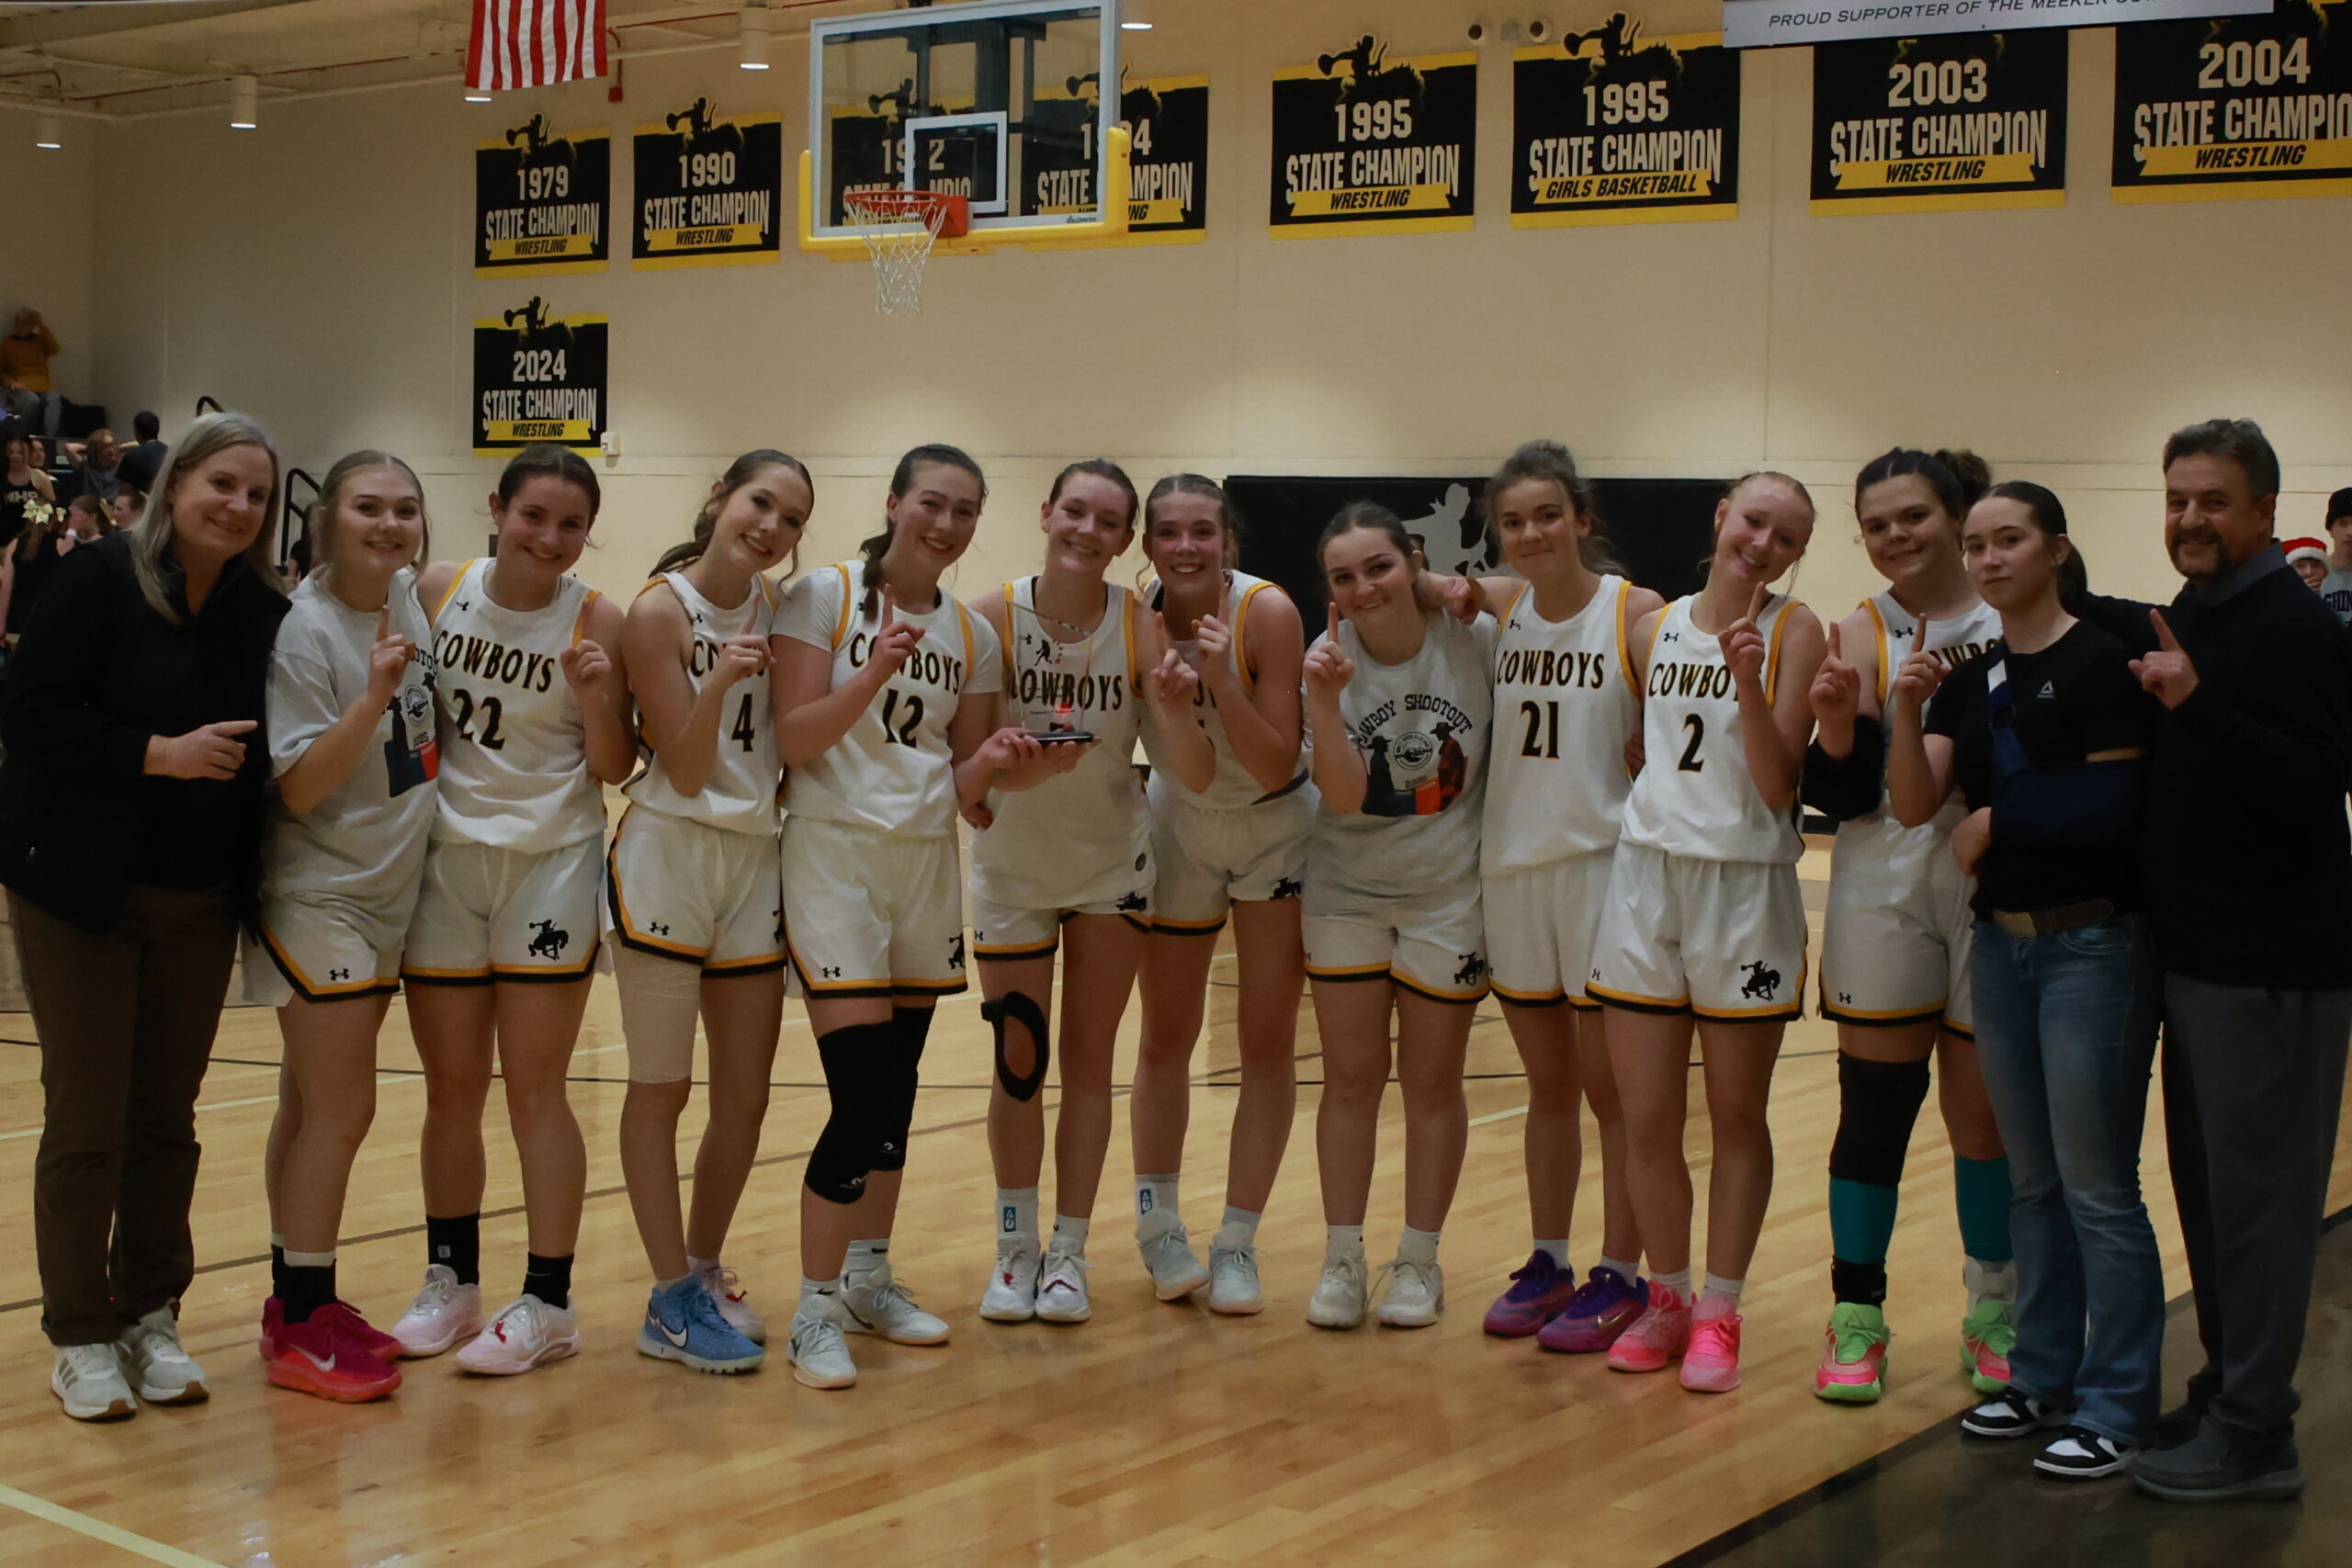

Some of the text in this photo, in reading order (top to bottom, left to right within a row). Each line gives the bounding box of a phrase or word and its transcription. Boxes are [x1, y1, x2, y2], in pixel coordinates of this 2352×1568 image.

[1769, 12, 1831, 28] PROUD
[1838, 4, 1949, 23] SUPPORTER
[1956, 2, 1980, 15] OF
[1988, 0, 2024, 12] THE
[1888, 59, 1986, 107] 2003
[2199, 37, 2311, 89] 2004
[1335, 99, 1413, 142] 1995
[1582, 81, 1668, 126] 1995
[1829, 109, 2047, 177] STATE CHAMPION
[2133, 93, 2352, 163] STATE CHAMPIO
[679, 151, 735, 188] 1990
[881, 139, 945, 175] 192
[1285, 144, 1460, 206] STATE CHAMPION
[1529, 128, 1722, 192] STATE CHAMPION
[1886, 160, 1985, 183] WRESTLING
[2196, 145, 2307, 169] WRESTLING
[517, 165, 569, 200] 1979
[1037, 169, 1091, 215] STATE
[1330, 190, 1409, 210] WRESTLING
[1546, 175, 1697, 199] GIRLS BASKETBALL
[485, 202, 600, 251] STATE CHAMPION
[643, 189, 770, 241] STATE CHAMPION
[675, 228, 734, 246] WRESTLING
[514, 238, 567, 255] WRESTLING
[513, 349, 567, 382] 2024
[482, 388, 597, 432] STATE CHAMPION
[512, 423, 565, 437] WRESTLING
[434, 630, 556, 693] COWBOYS
[850, 633, 962, 695] CBOYS
[1496, 649, 1604, 689] COWBOYS
[1648, 662, 1739, 702] COWBO
[452, 689, 504, 750] 22
[731, 694, 755, 752] 4
[884, 689, 923, 749] 12
[1405, 694, 1474, 735] SHOOTOUT
[1521, 701, 1560, 759] 21
[1678, 713, 1705, 773] 2
